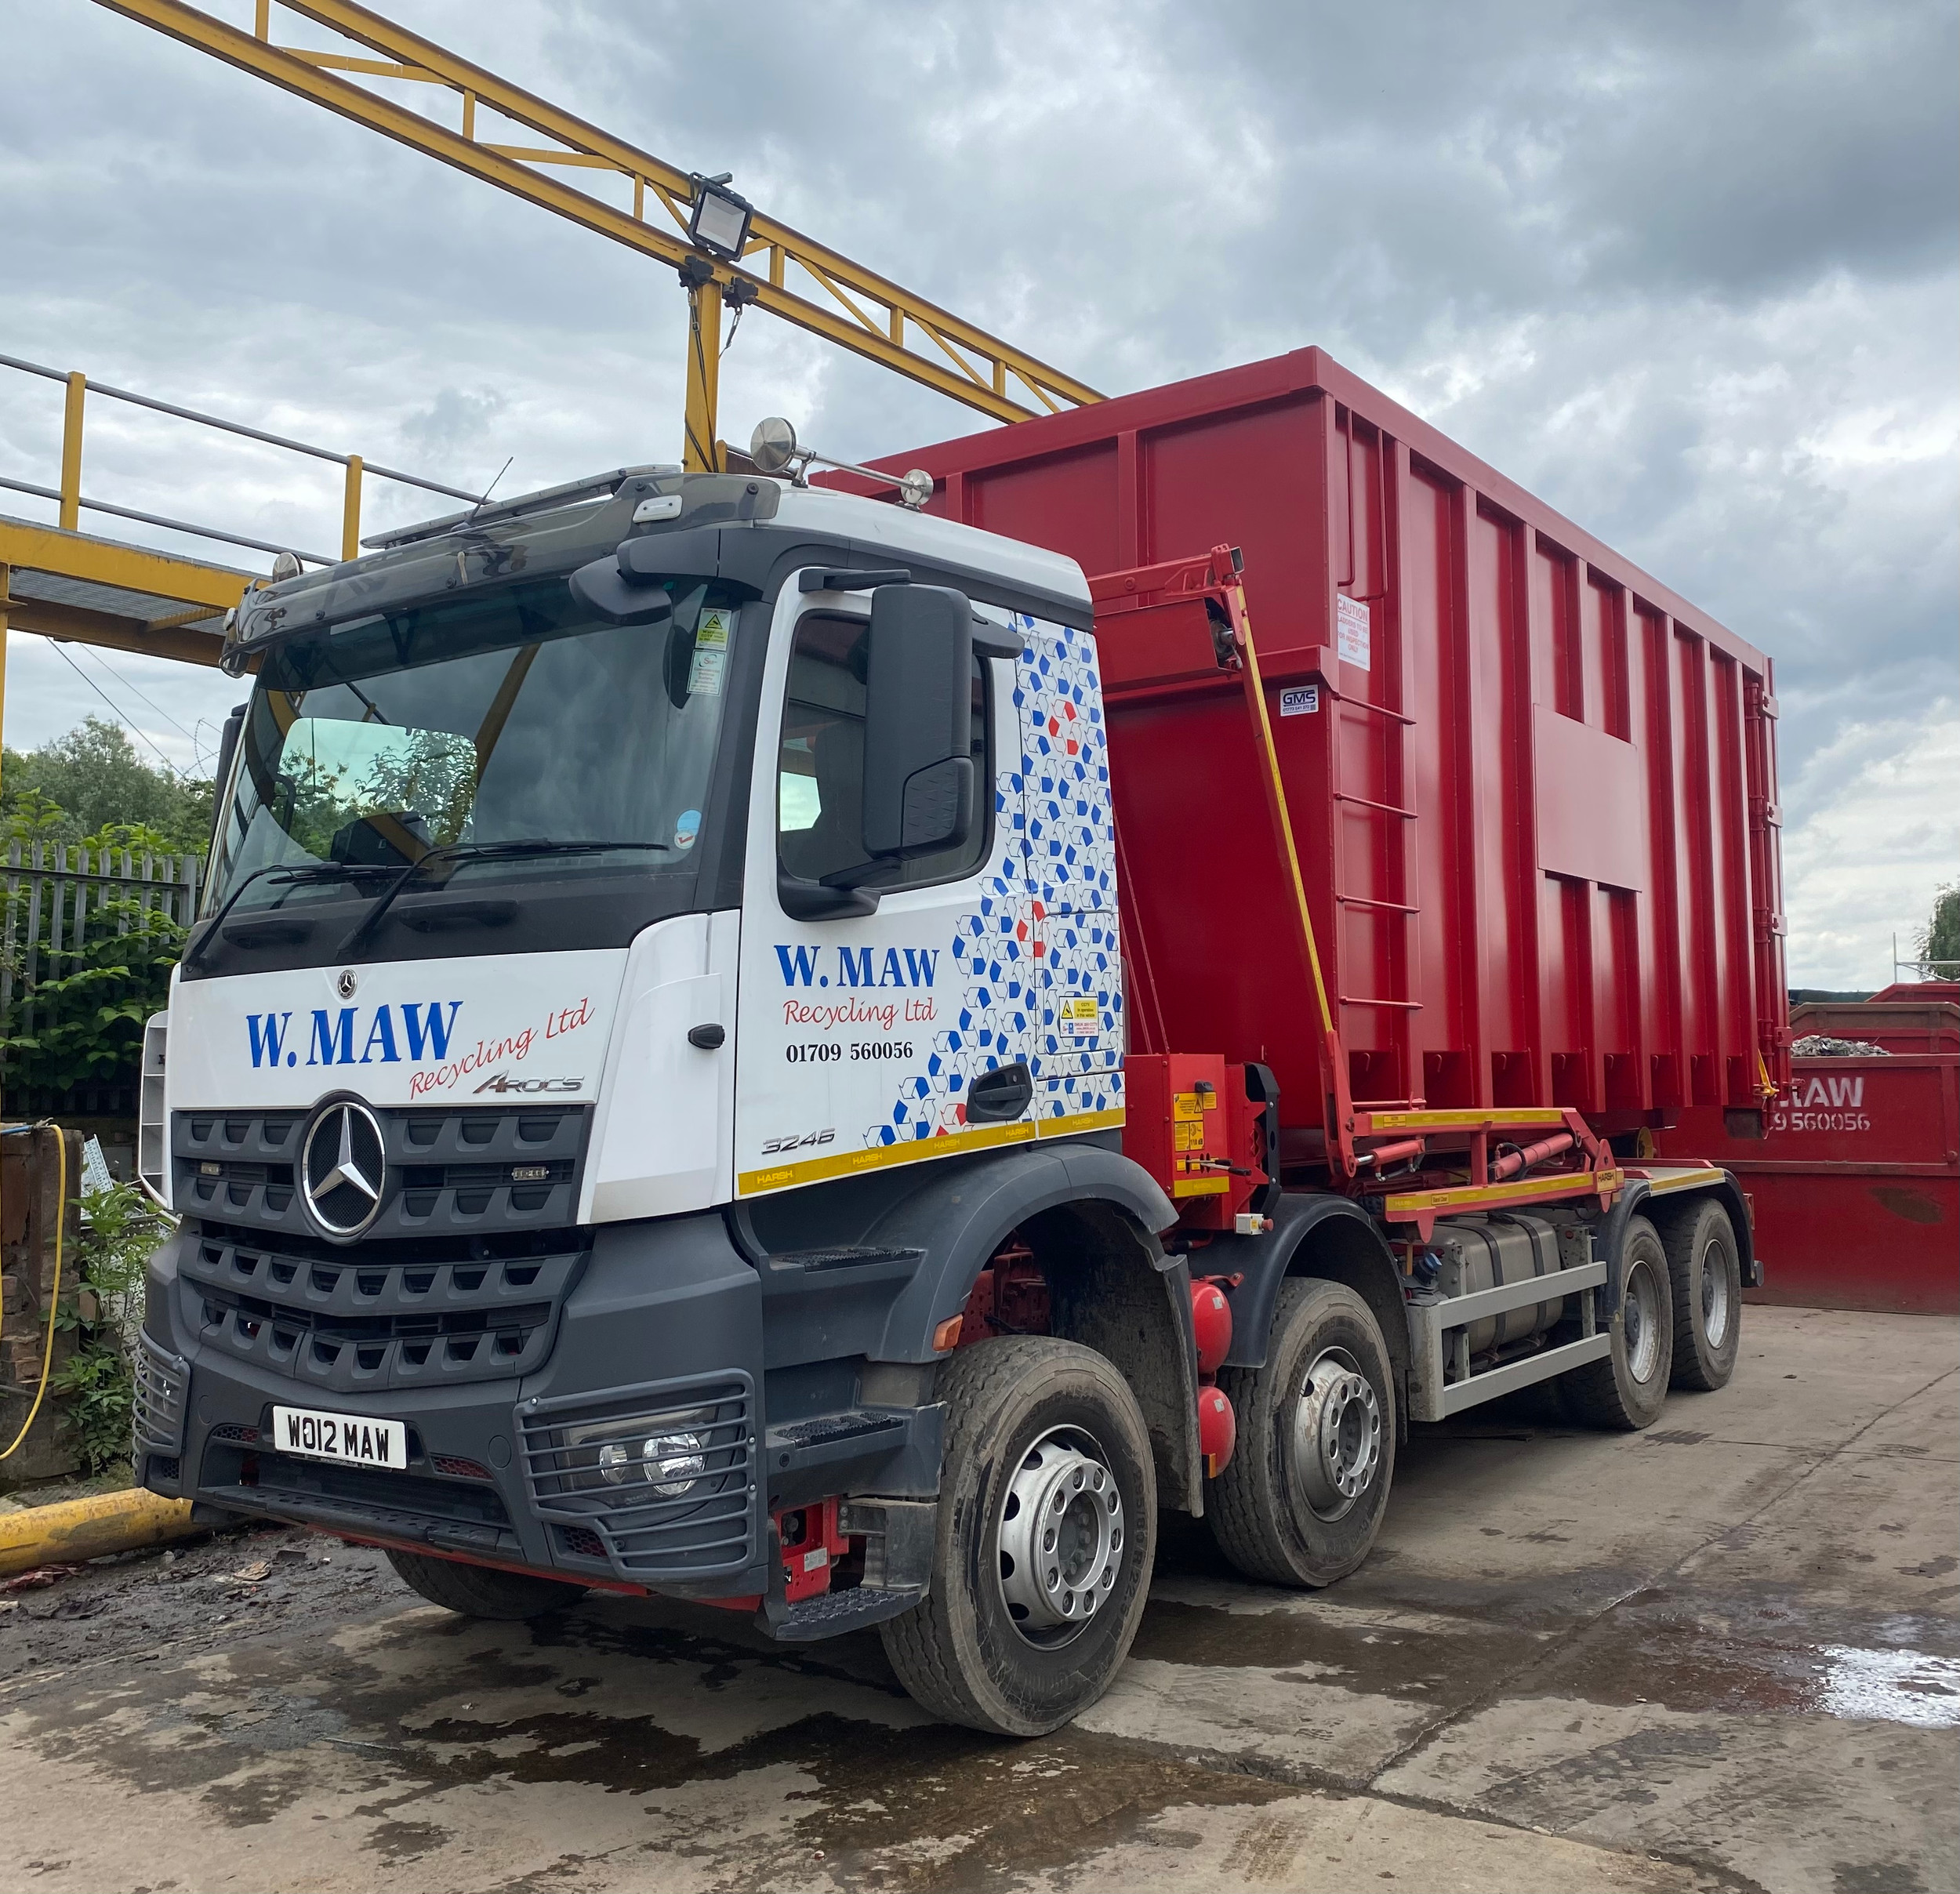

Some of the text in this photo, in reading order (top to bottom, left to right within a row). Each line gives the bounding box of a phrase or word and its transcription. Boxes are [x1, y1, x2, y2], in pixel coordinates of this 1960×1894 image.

[1338, 599, 1368, 622] CAUTION
[1283, 690, 1316, 704] GMS
[783, 996, 938, 1030] Recycling Ltd
[410, 996, 596, 1100] Recycling Ltd
[786, 1041, 913, 1063] 01709 560056
[1072, 1117, 1094, 1126] HARSH
[1791, 1112, 1871, 1131] 560056
[1005, 1127, 1029, 1137] HARSH
[761, 1127, 836, 1155] 3246
[934, 1138, 960, 1149] HARSH
[853, 1152, 883, 1165] HARSH
[757, 1170, 793, 1185] HARSH
[1599, 1172, 1614, 1182] HARSH
[288, 1414, 389, 1462] WO12 MAW
